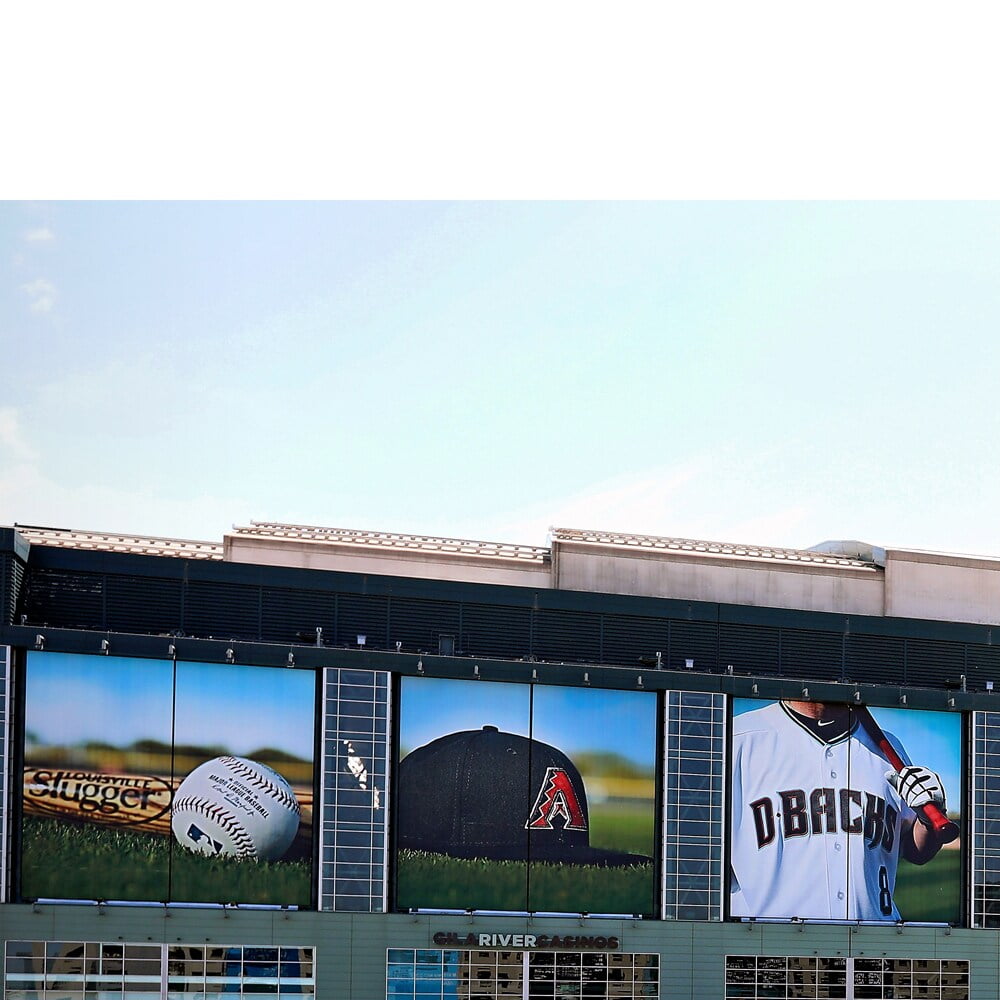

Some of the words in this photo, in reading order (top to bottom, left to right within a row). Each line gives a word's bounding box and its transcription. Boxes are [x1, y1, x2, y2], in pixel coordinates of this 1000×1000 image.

[29, 771, 156, 814] Slugger
[62, 772, 152, 788] LOUISVILLE
[233, 780, 254, 796] OFFICIAL
[208, 774, 229, 787] MAJOR
[226, 783, 246, 800] LEAGUE
[243, 794, 270, 819] BASEBALL
[878, 865, 893, 917] 8
[479, 932, 537, 948] RIVER
